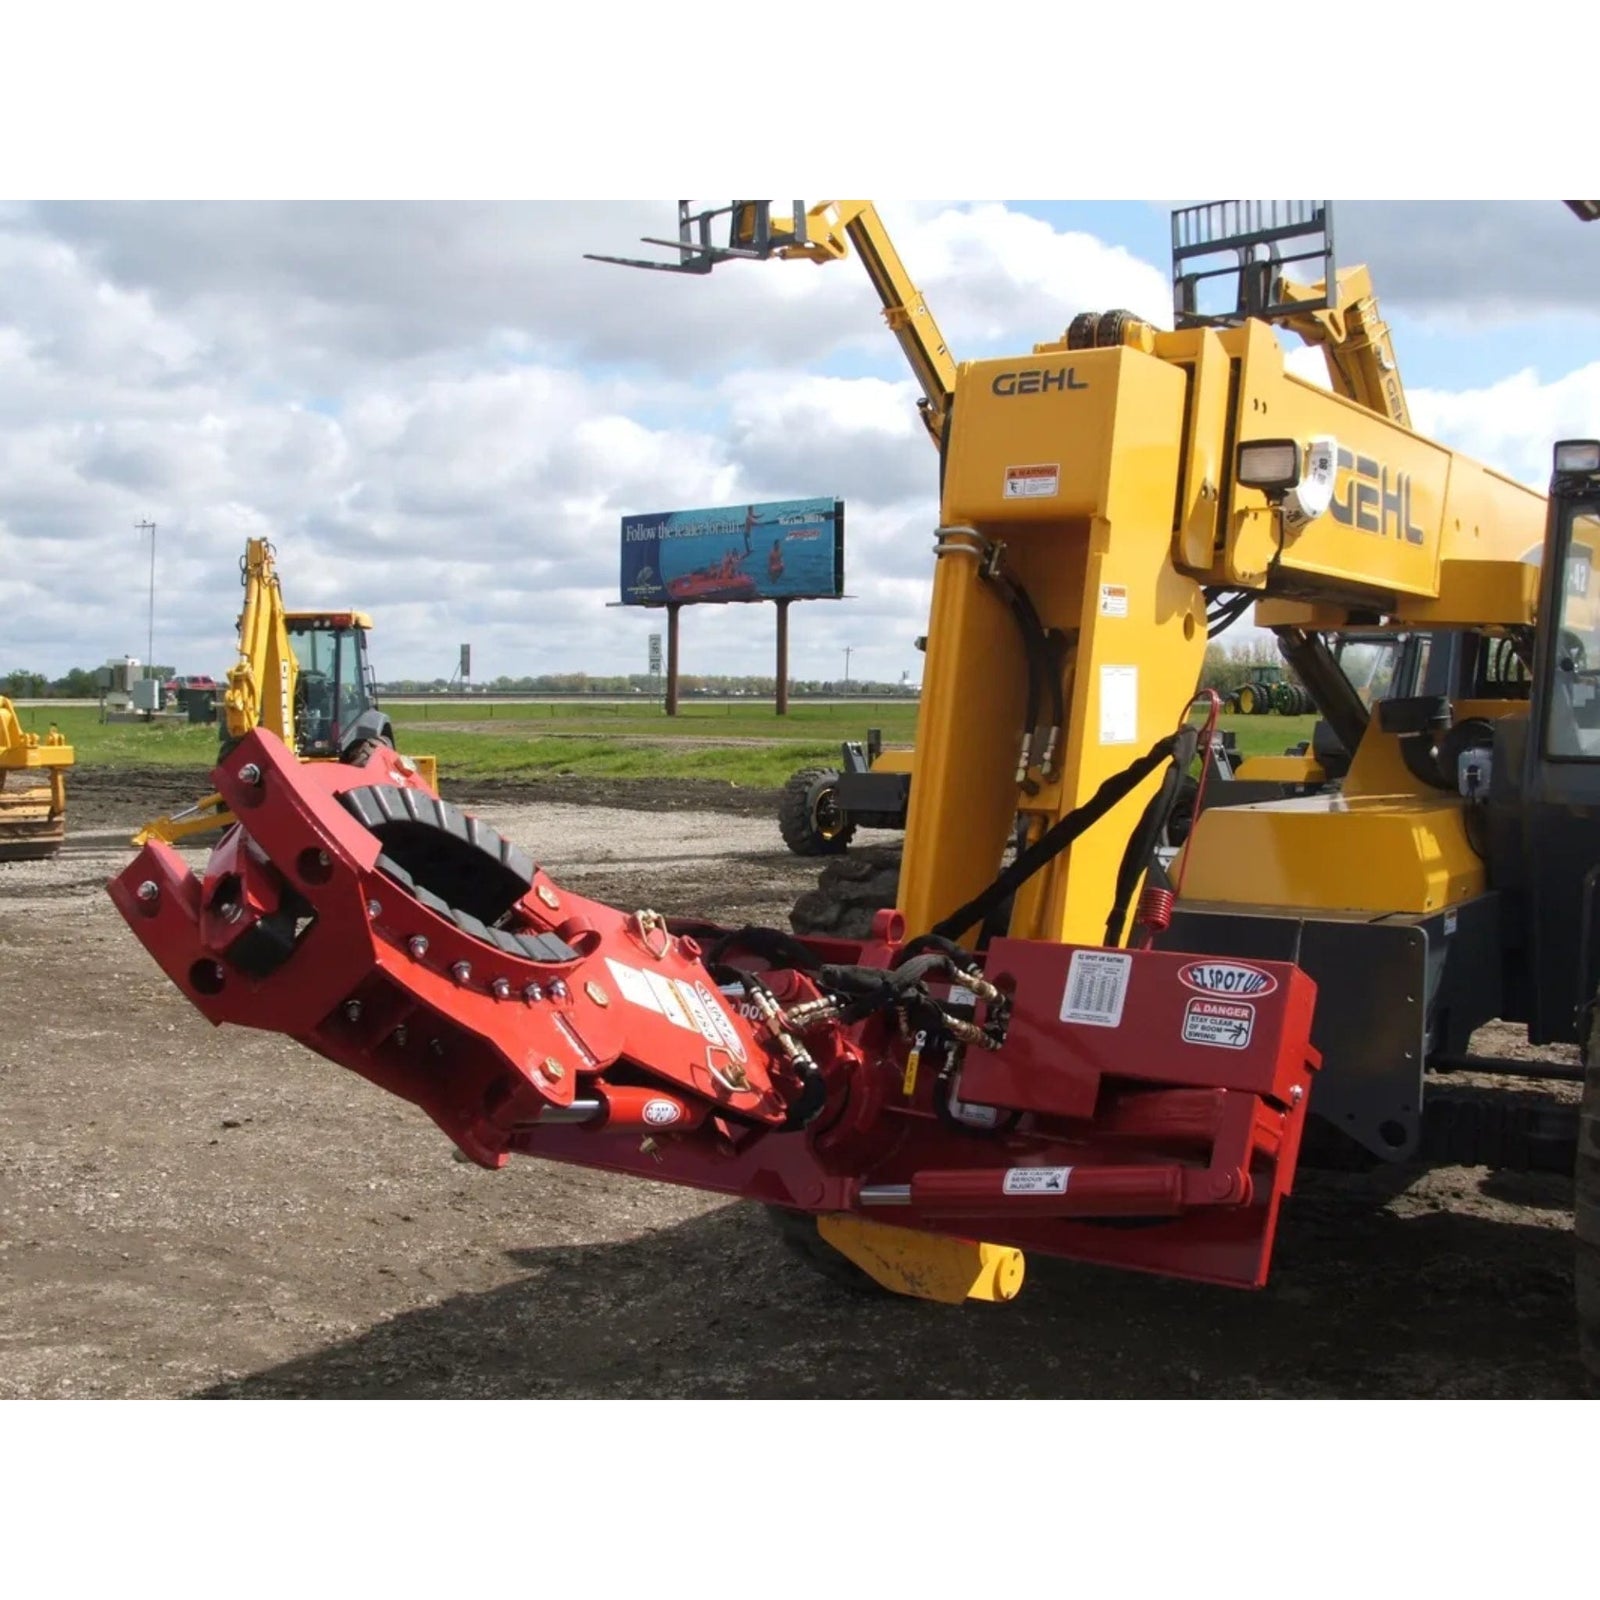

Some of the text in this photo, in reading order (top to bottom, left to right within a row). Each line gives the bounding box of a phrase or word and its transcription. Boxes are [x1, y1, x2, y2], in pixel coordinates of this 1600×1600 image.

[992, 367, 1088, 395] GEHL
[1329, 447, 1424, 546] GEHL
[626, 523, 657, 542] Follow
[658, 521, 672, 539] the
[674, 519, 703, 537] leader
[705, 519, 720, 536] for
[1190, 967, 1268, 993] EZ SPOT UR
[1203, 1003, 1250, 1019] DANGER
[1191, 1016, 1233, 1027] STAY CLEAR
[1201, 1024, 1223, 1033] BOOM
[1187, 1030, 1217, 1040] SWING
